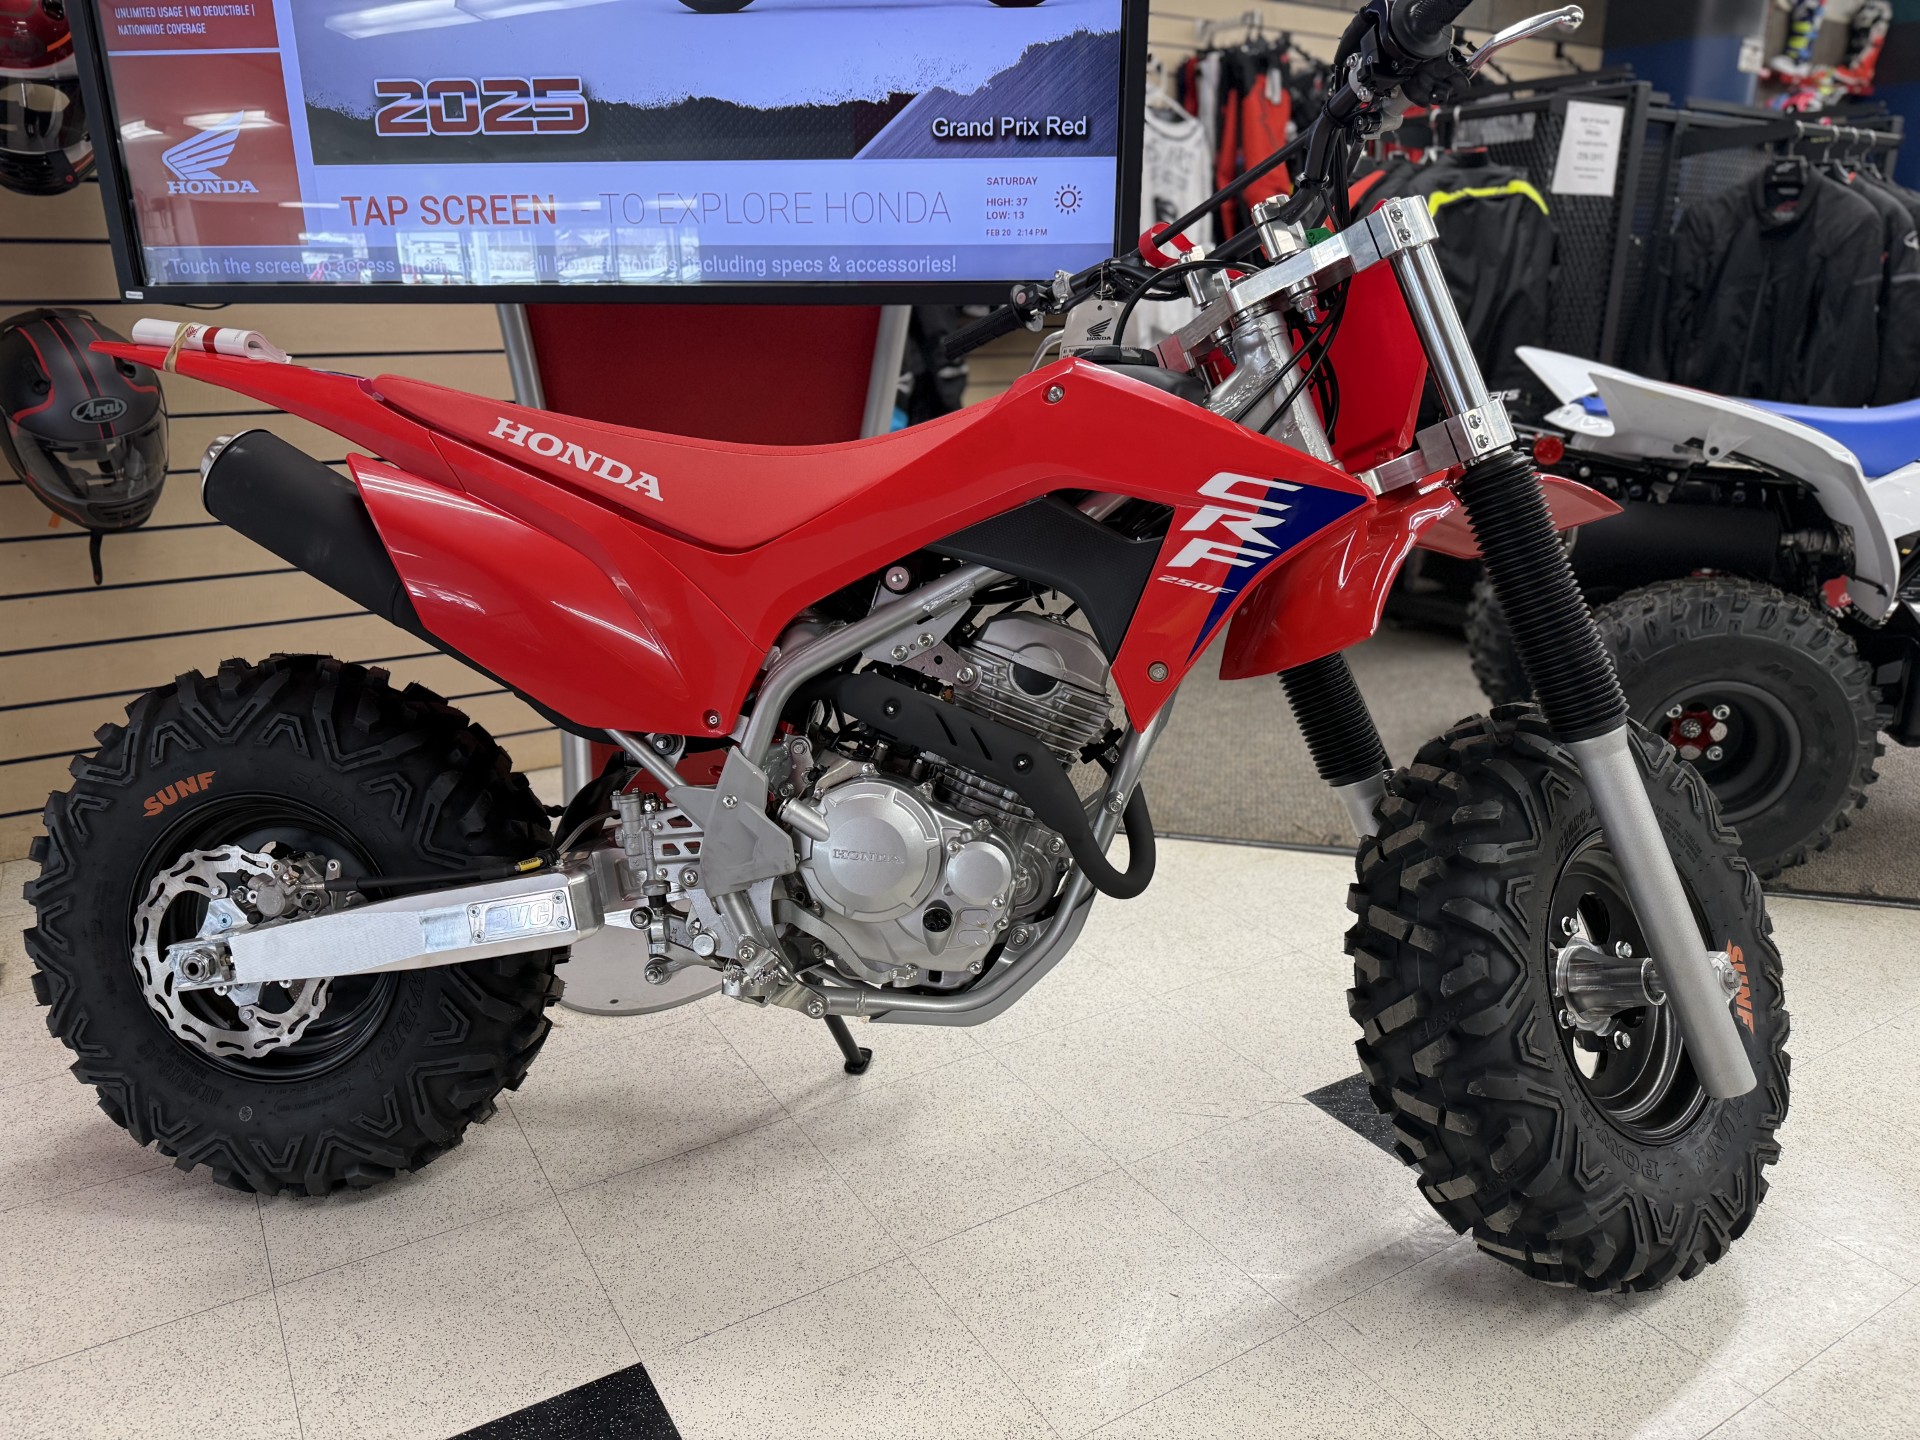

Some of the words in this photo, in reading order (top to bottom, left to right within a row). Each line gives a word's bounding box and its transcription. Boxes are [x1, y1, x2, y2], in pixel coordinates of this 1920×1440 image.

[115, 6, 156, 19] UNLIMITED
[157, 5, 183, 18] USAGE
[190, 5, 201, 17] NO
[202, 4, 250, 17] DEDUCTIBLE
[117, 23, 165, 35] NATIONWIDE
[166, 22, 206, 34] COVERAGE
[373, 75, 589, 136] 2025
[931, 116, 994, 138] Grand
[1001, 116, 1040, 137] Prix
[1045, 115, 1087, 136] Red
[167, 179, 259, 194] HONDA
[986, 175, 1038, 186] SATURDAY
[340, 195, 408, 226] TAP
[420, 194, 557, 226] SCREEN
[598, 192, 645, 225] TO
[657, 191, 813, 225] EXPLORE
[825, 190, 952, 224] HONDA
[986, 197, 1013, 207] HIGH:
[1015, 197, 1028, 206] 37
[986, 210, 1011, 220] LOW:
[1012, 210, 1025, 220] 13
[986, 228, 1001, 237] FEB
[1001, 228, 1012, 236] 20
[1017, 228, 1033, 237] 2:14
[1034, 228, 1048, 236] PM
[171, 257, 220, 275] Touch
[224, 257, 251, 274] the
[255, 260, 312, 274] screen
[336, 259, 395, 274] access
[529, 255, 548, 273] all
[686, 255, 767, 277] including
[771, 258, 824, 277] specs
[828, 256, 842, 273] &
[845, 255, 957, 273] accessories!
[488, 416, 664, 501] HONDA
[1166, 471, 1304, 568] CRF
[1157, 574, 1238, 595] 250F
[143, 770, 217, 817] SUNF
[833, 849, 904, 863] HONDA
[486, 900, 550, 933] BVC
